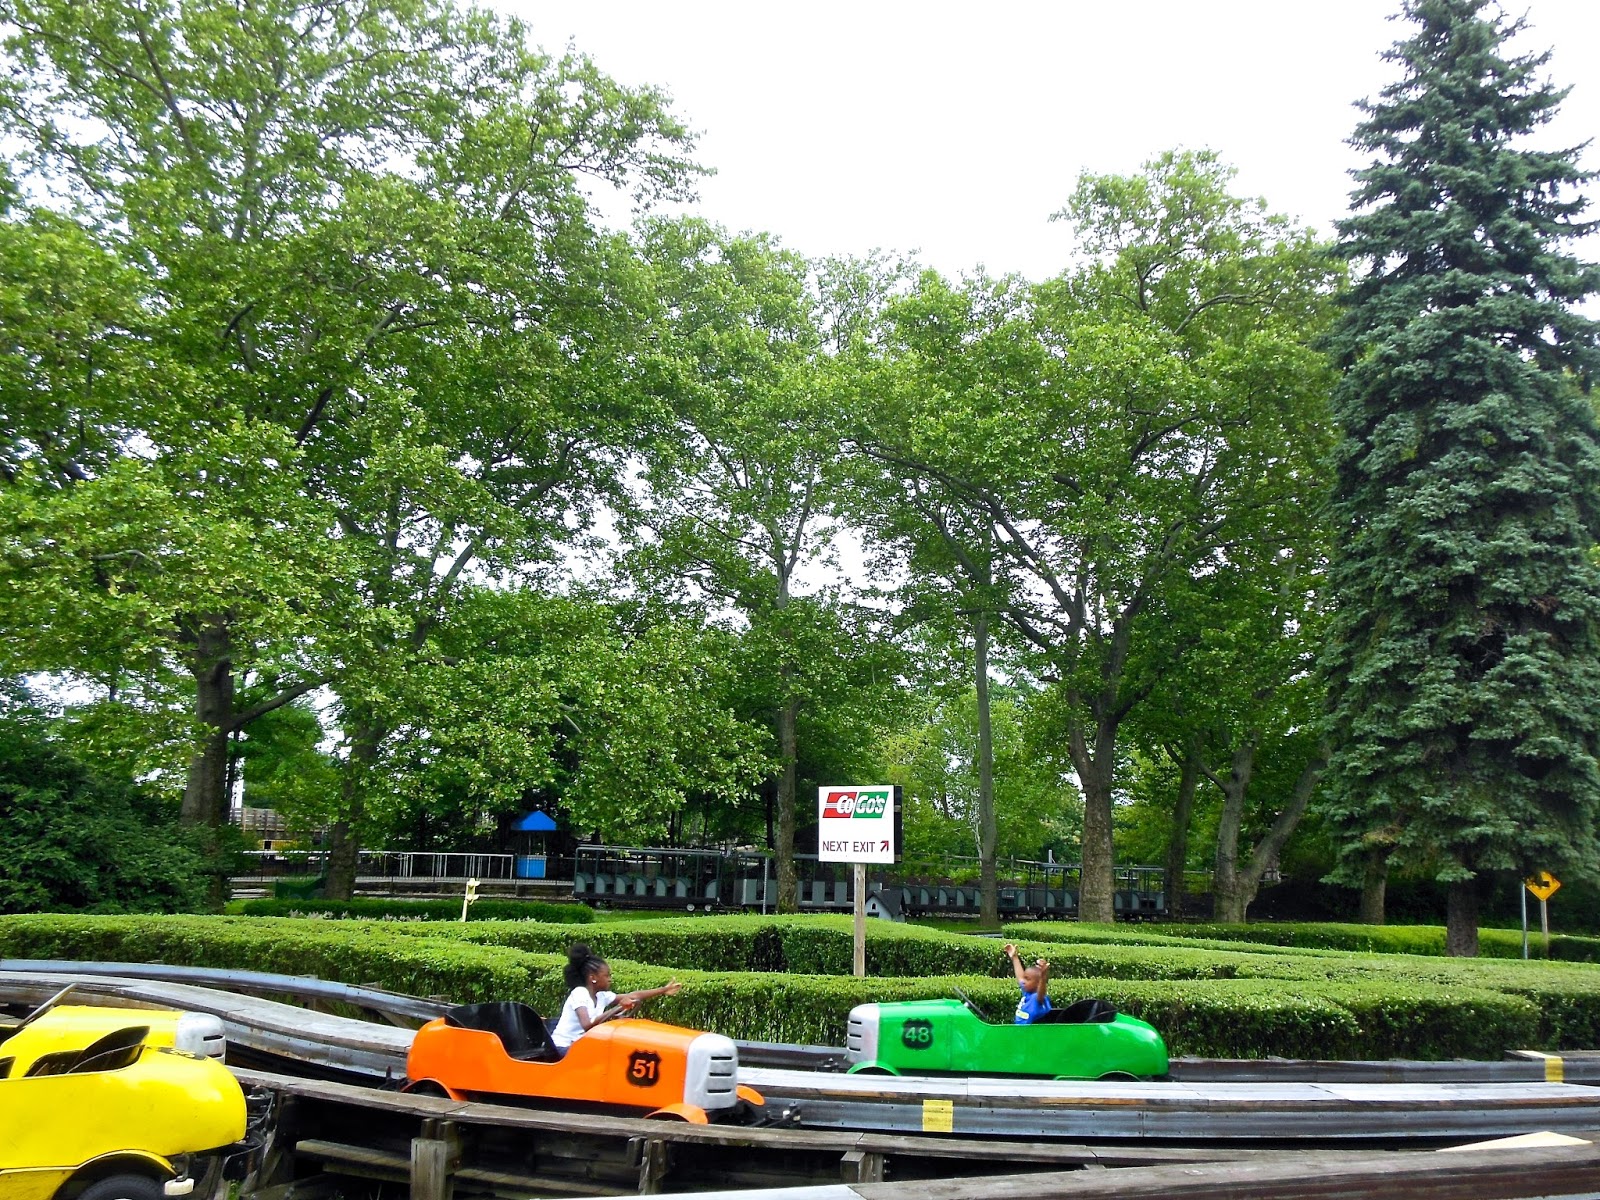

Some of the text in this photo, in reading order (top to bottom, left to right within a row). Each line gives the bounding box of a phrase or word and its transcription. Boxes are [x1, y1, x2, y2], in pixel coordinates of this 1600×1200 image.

[822, 841, 876, 853] NEXT EXIT
[905, 1027, 929, 1042] 48
[632, 1059, 655, 1079] 51
